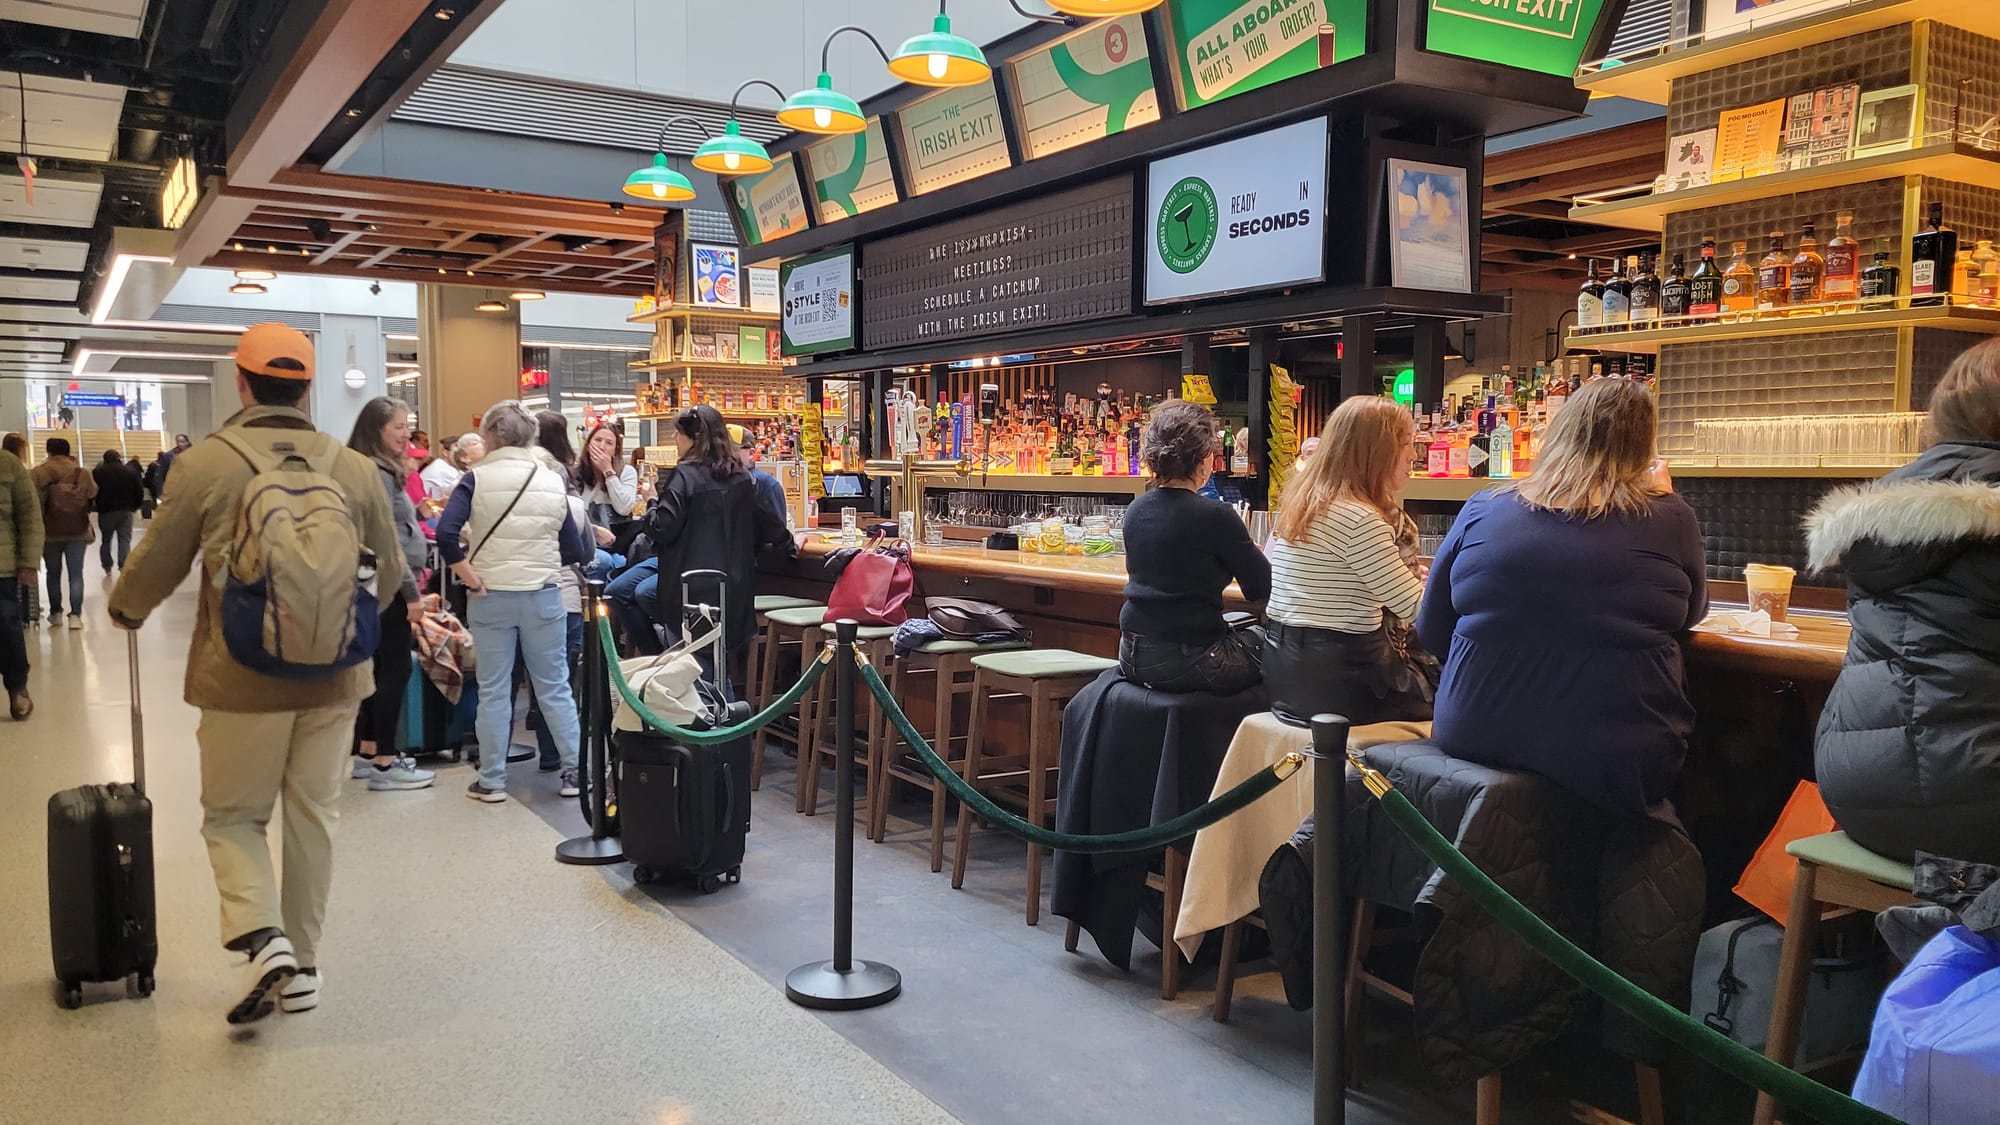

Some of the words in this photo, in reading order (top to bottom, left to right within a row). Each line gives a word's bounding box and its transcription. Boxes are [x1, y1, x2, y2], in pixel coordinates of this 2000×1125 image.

[1516, 0, 1573, 22] EXIT
[1110, 32, 1124, 54] 3
[1196, 34, 1229, 65] ALL
[1231, 0, 1297, 42] ABOA
[1200, 55, 1233, 88] WHAT'S
[1243, 33, 1268, 62] YOUR
[1280, 2, 1317, 40] ORDER?
[942, 104, 960, 120] THE
[919, 127, 957, 157] IRISH
[960, 113, 993, 143] EXIT
[1183, 183, 1203, 194] EXPRESS
[1231, 192, 1256, 215] READY
[1299, 180, 1309, 200] IN
[1229, 209, 1310, 239] SECONDS
[1160, 226, 1169, 255] EXPRESS
[1195, 234, 1212, 261] EXPRESS
[954, 255, 1012, 279] MEETINGS?
[924, 290, 972, 310] SCHEDULE
[979, 287, 985, 300] A
[992, 276, 1040, 298] CATCHUP
[1691, 281, 1713, 291] LOST
[1691, 290, 1713, 300] IRISH
[794, 292, 820, 309] STYLE
[918, 320, 941, 335] WITH
[948, 316, 965, 331] THE
[973, 310, 1004, 327] IRISH
[1013, 303, 1047, 321] EXIT!
